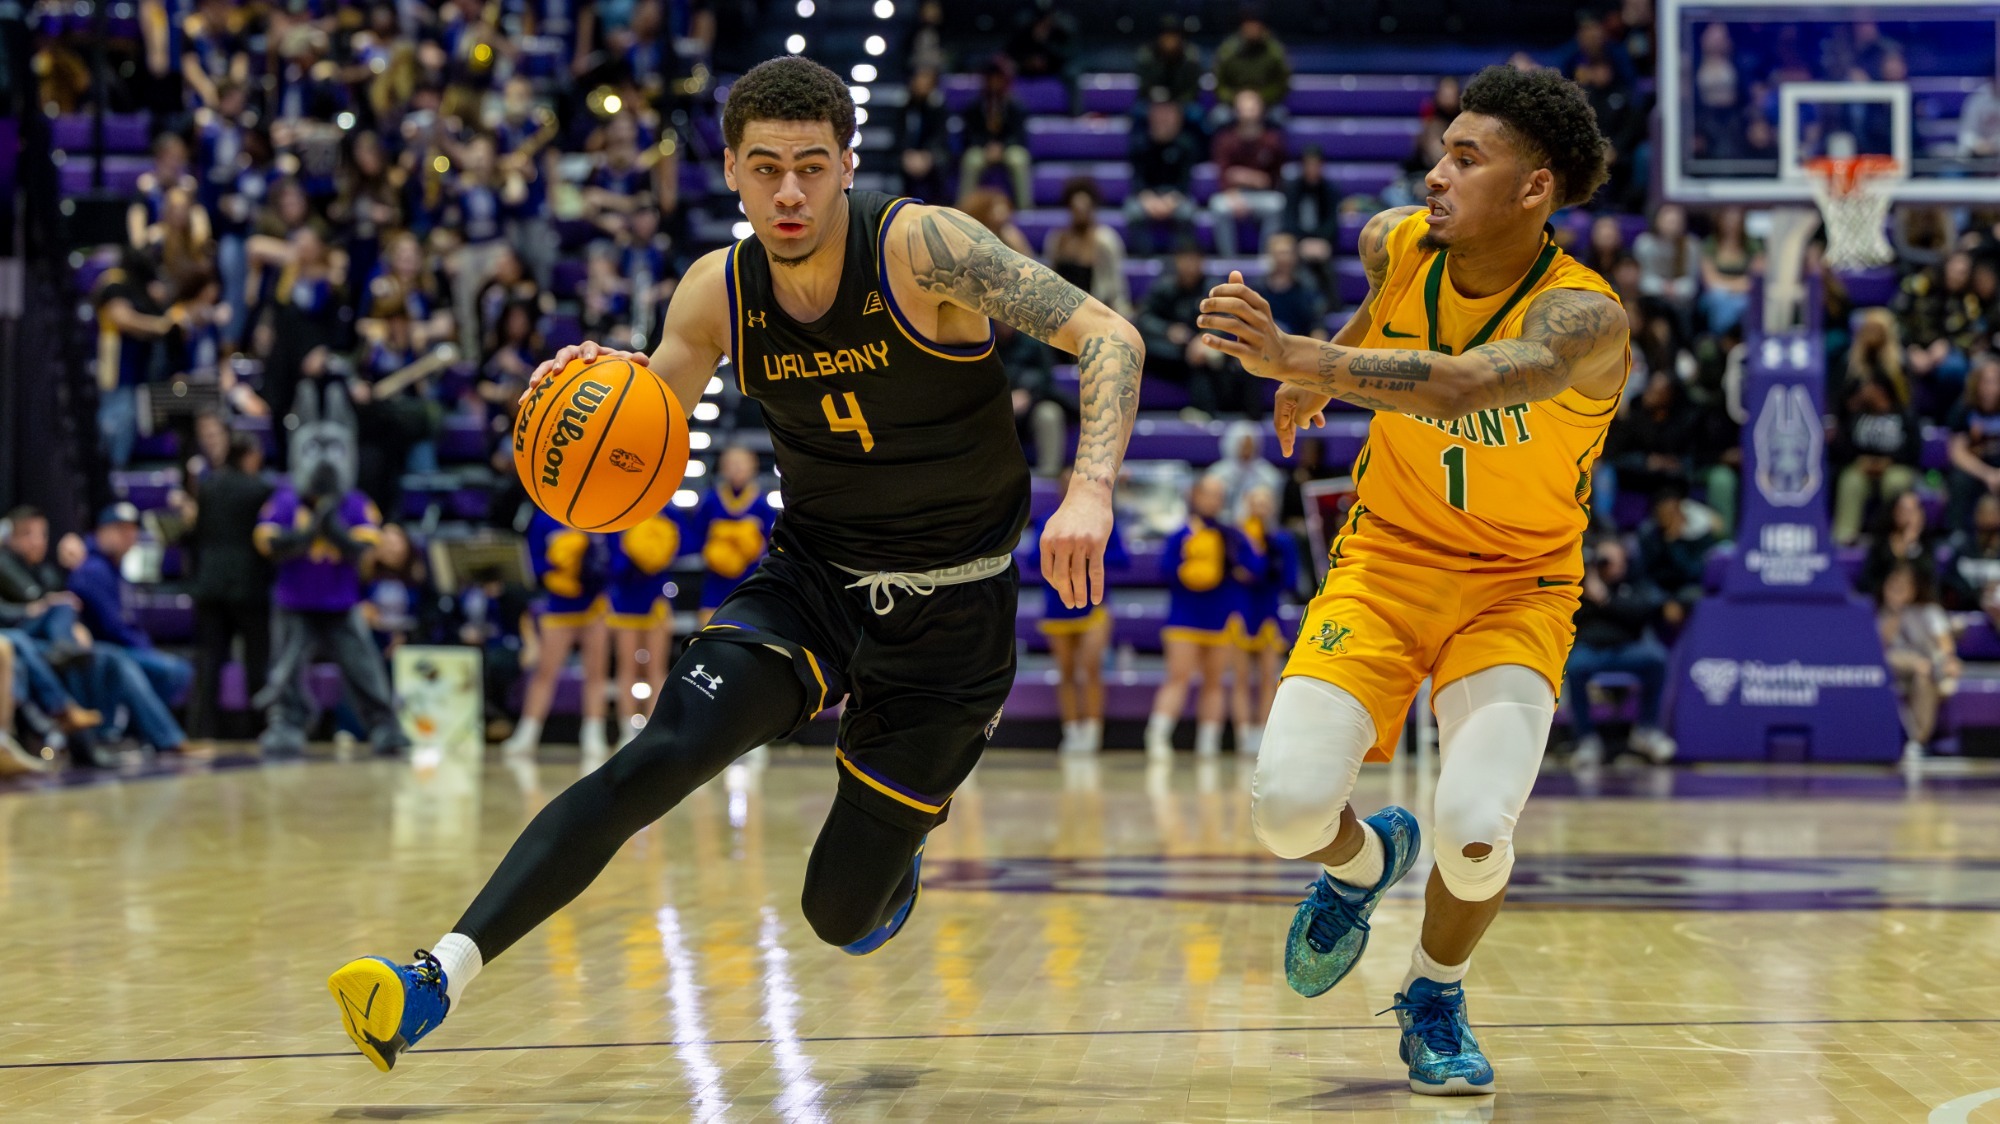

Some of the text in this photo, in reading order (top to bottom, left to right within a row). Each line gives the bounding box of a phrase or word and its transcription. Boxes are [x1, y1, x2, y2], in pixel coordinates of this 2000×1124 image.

[763, 340, 889, 380] UALBANY
[516, 377, 554, 452] NCAA
[541, 380, 613, 487] Wilson
[821, 391, 875, 453] 4
[1440, 443, 1469, 513] 1
